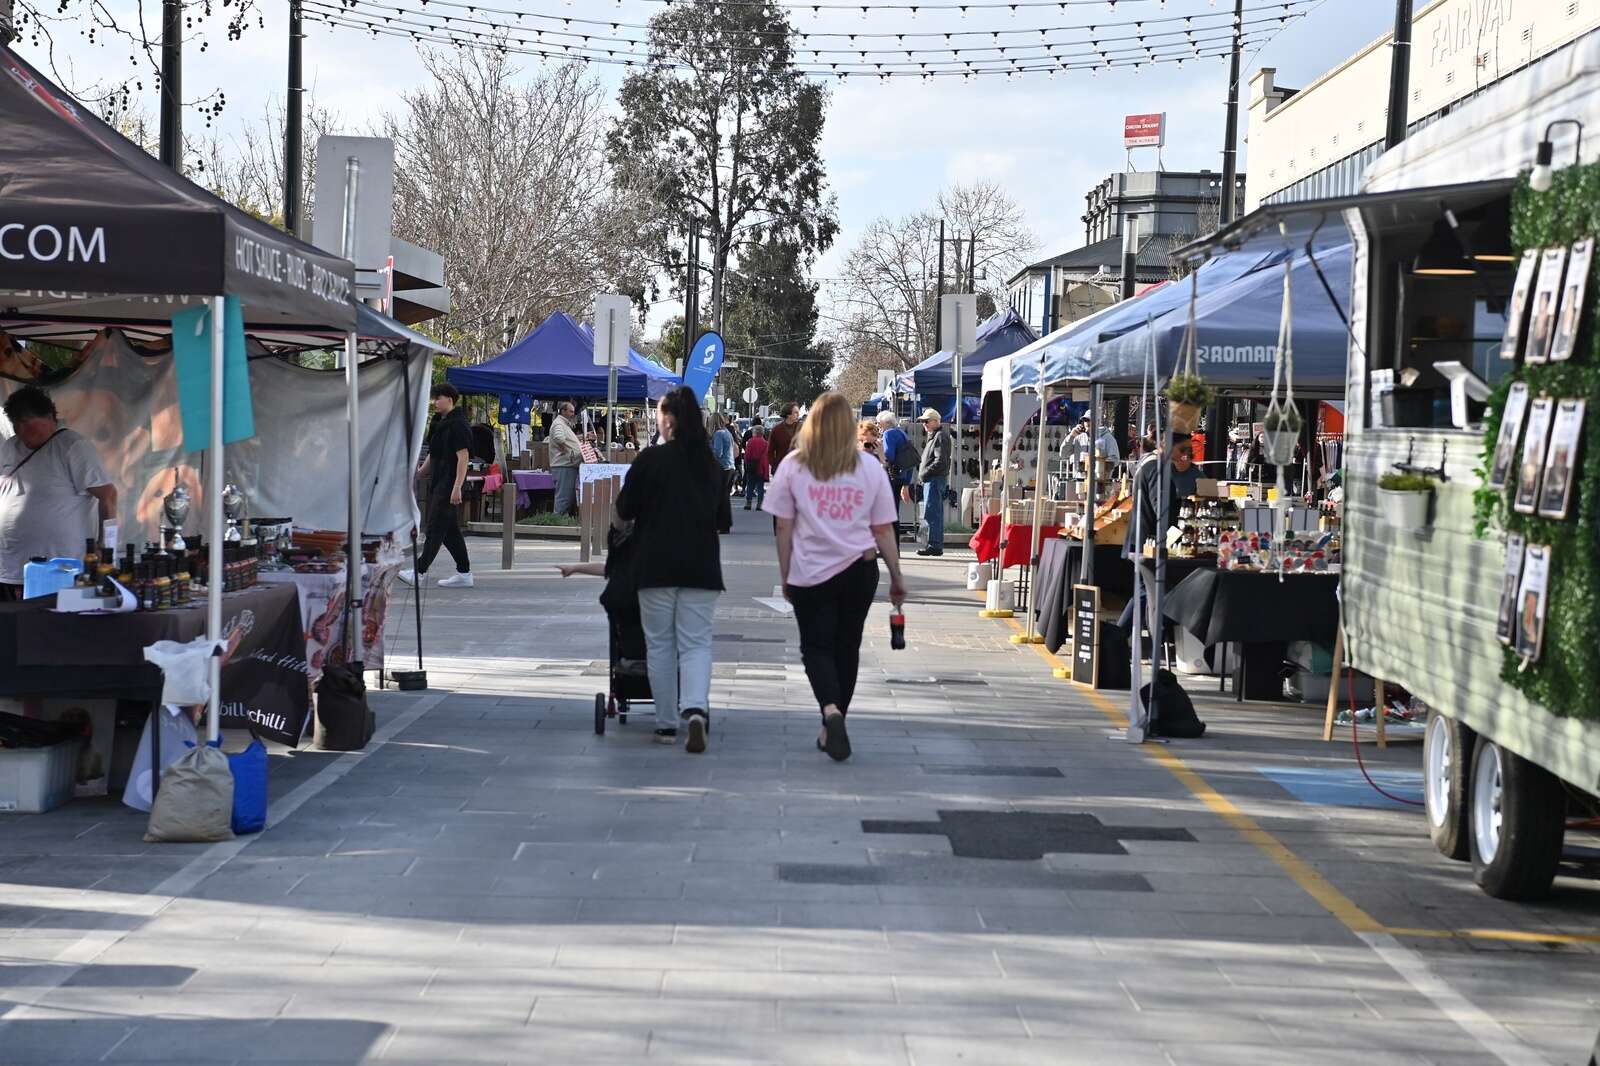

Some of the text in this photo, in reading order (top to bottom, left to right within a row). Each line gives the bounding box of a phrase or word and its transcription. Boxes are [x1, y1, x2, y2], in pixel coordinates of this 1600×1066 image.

[235, 235, 255, 274] HOT
[255, 243, 282, 283] SAUCE
[808, 484, 865, 506] WHITE
[816, 499, 853, 521] FOX
